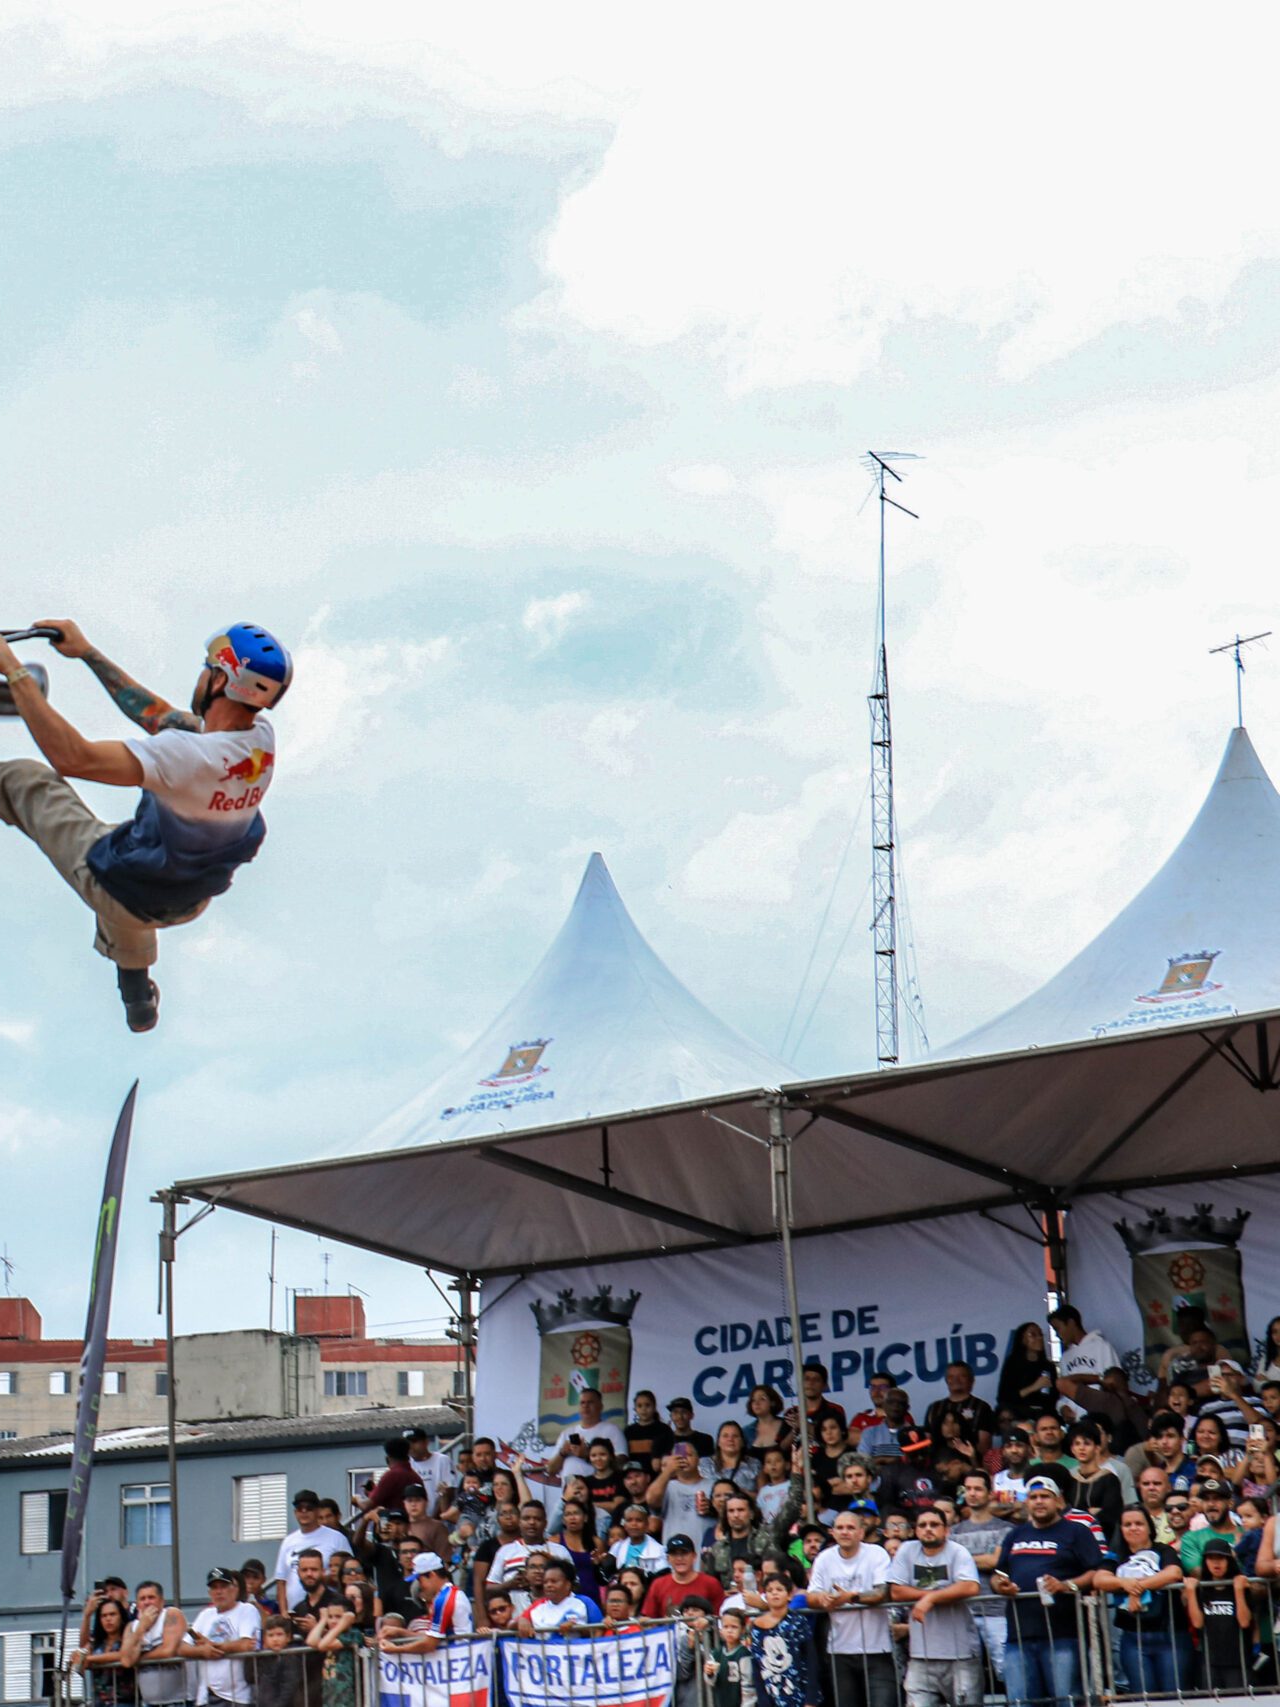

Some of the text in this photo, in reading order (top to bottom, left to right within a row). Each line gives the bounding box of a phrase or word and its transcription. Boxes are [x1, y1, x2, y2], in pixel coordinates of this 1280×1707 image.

[208, 788, 249, 811] Red
[694, 1305, 880, 1356] CIDADE DE
[692, 1323, 1018, 1408] CARPICUÍB
[1011, 1540, 1058, 1550] DAF
[511, 1642, 672, 1687] FORTALEZA
